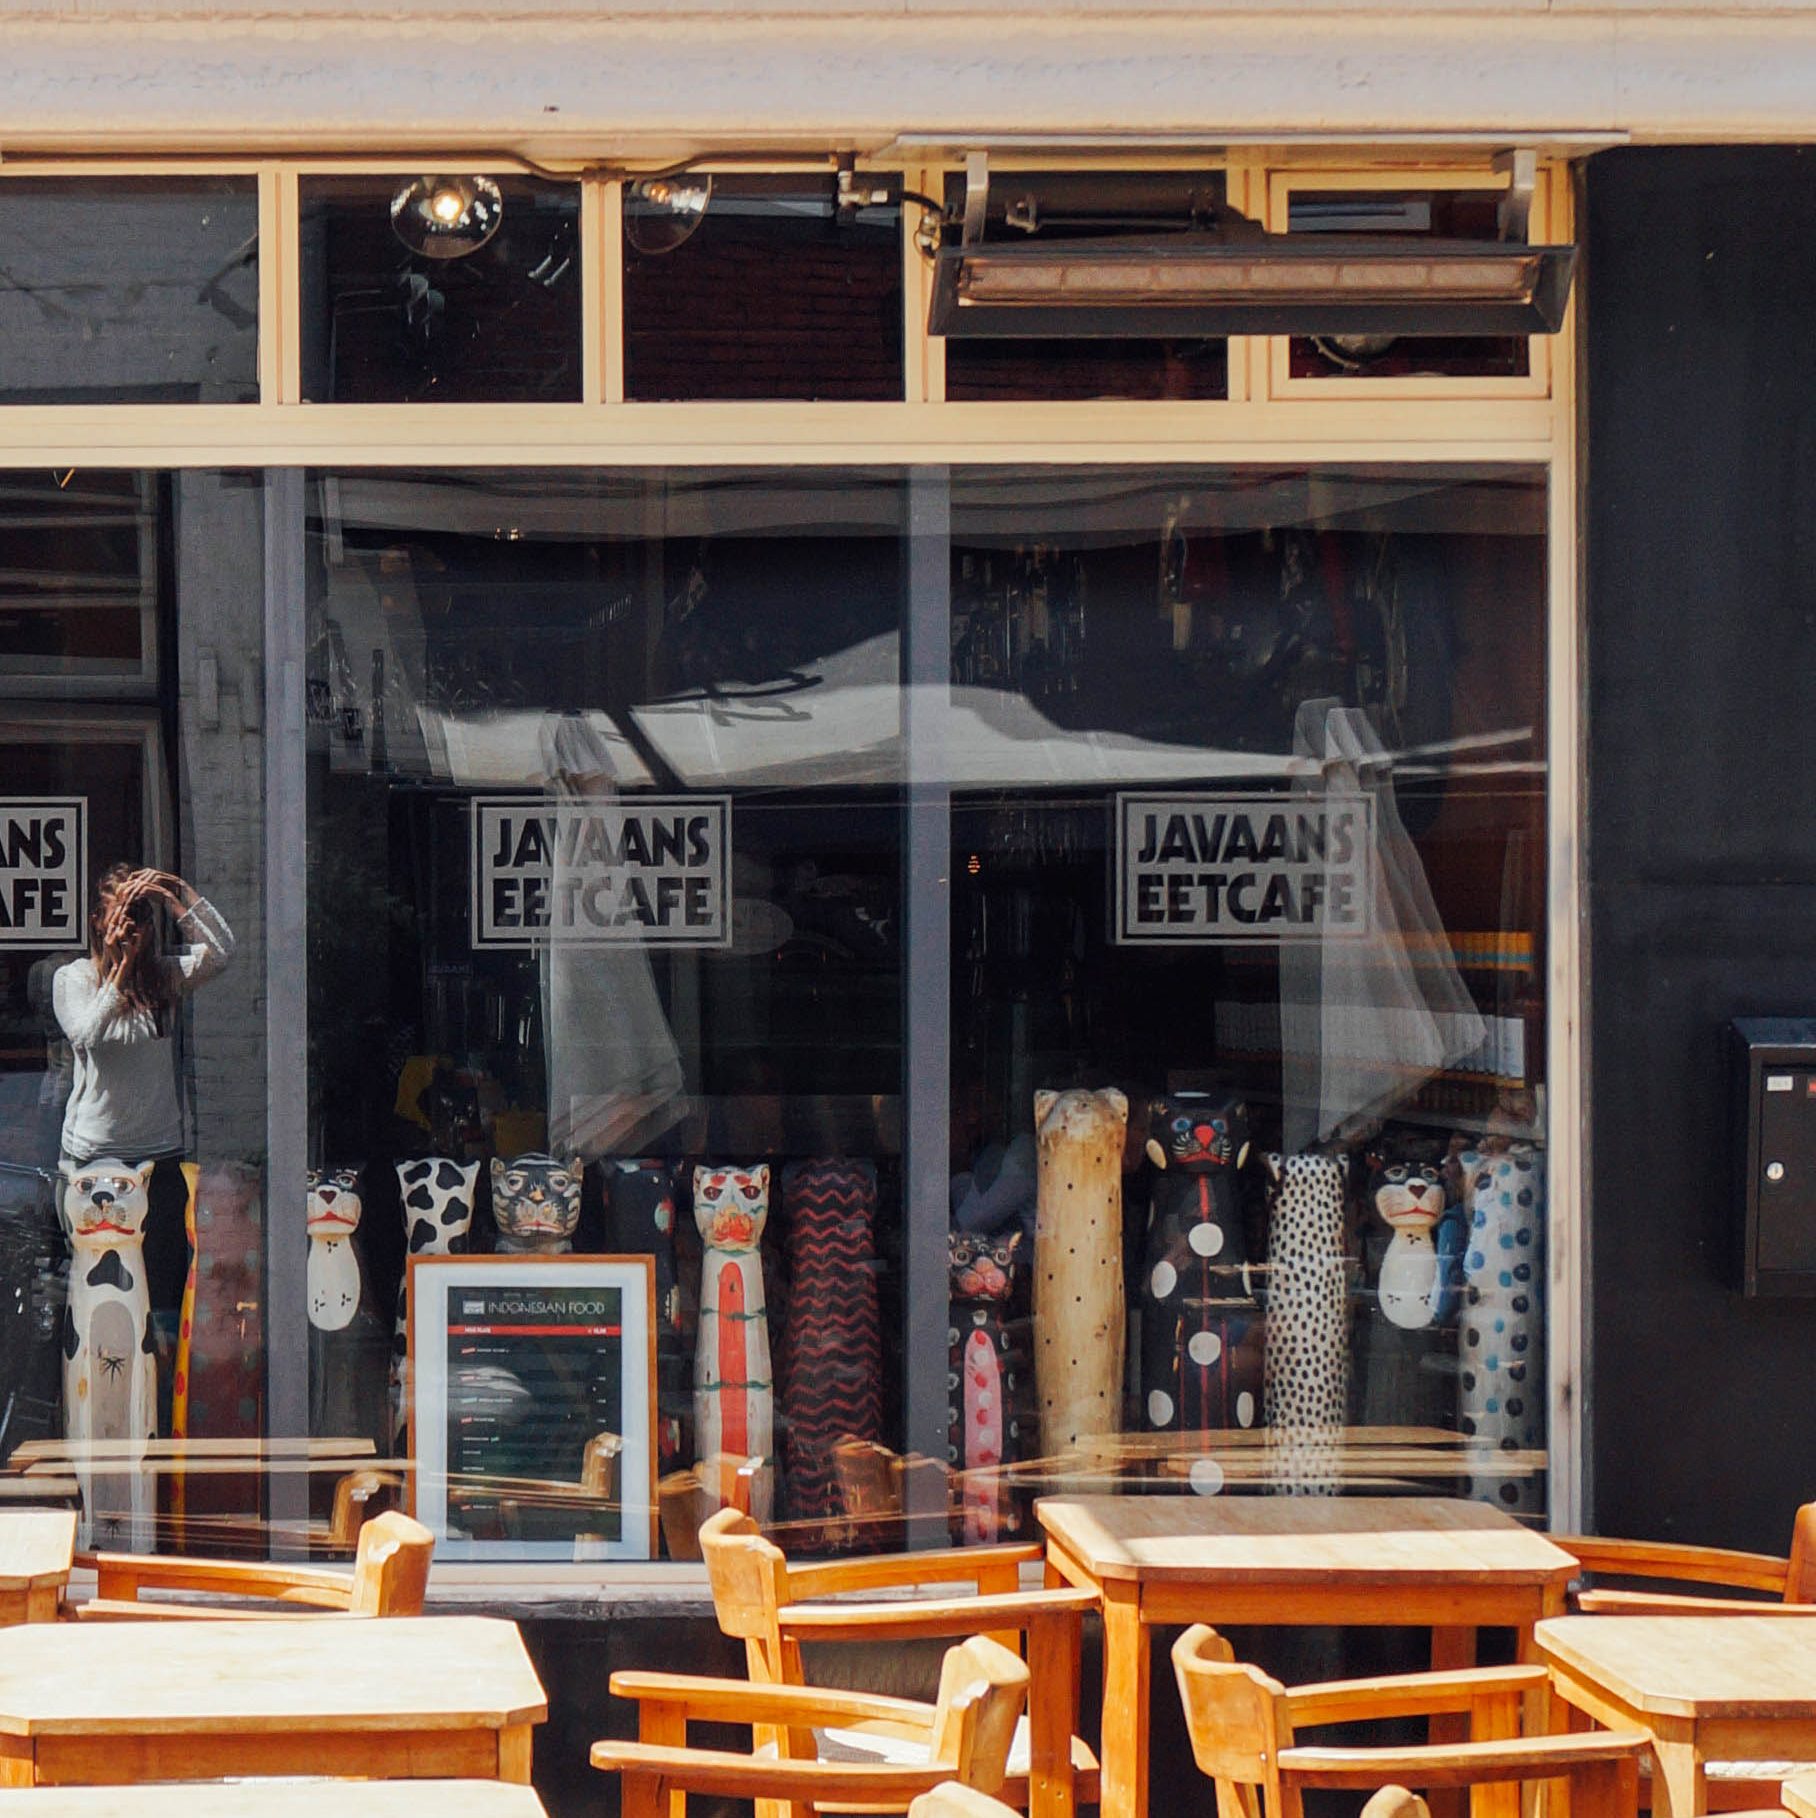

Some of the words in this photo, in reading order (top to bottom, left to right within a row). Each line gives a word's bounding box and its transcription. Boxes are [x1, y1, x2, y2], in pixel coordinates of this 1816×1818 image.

[492, 816, 711, 868] JAVAANS
[1137, 813, 1353, 864] JAVAANS
[492, 876, 714, 928] EETCAFE
[1137, 872, 1357, 924] EETCAFE
[488, 1300, 566, 1315] INDONESIAN
[568, 1301, 605, 1315] FOOD
